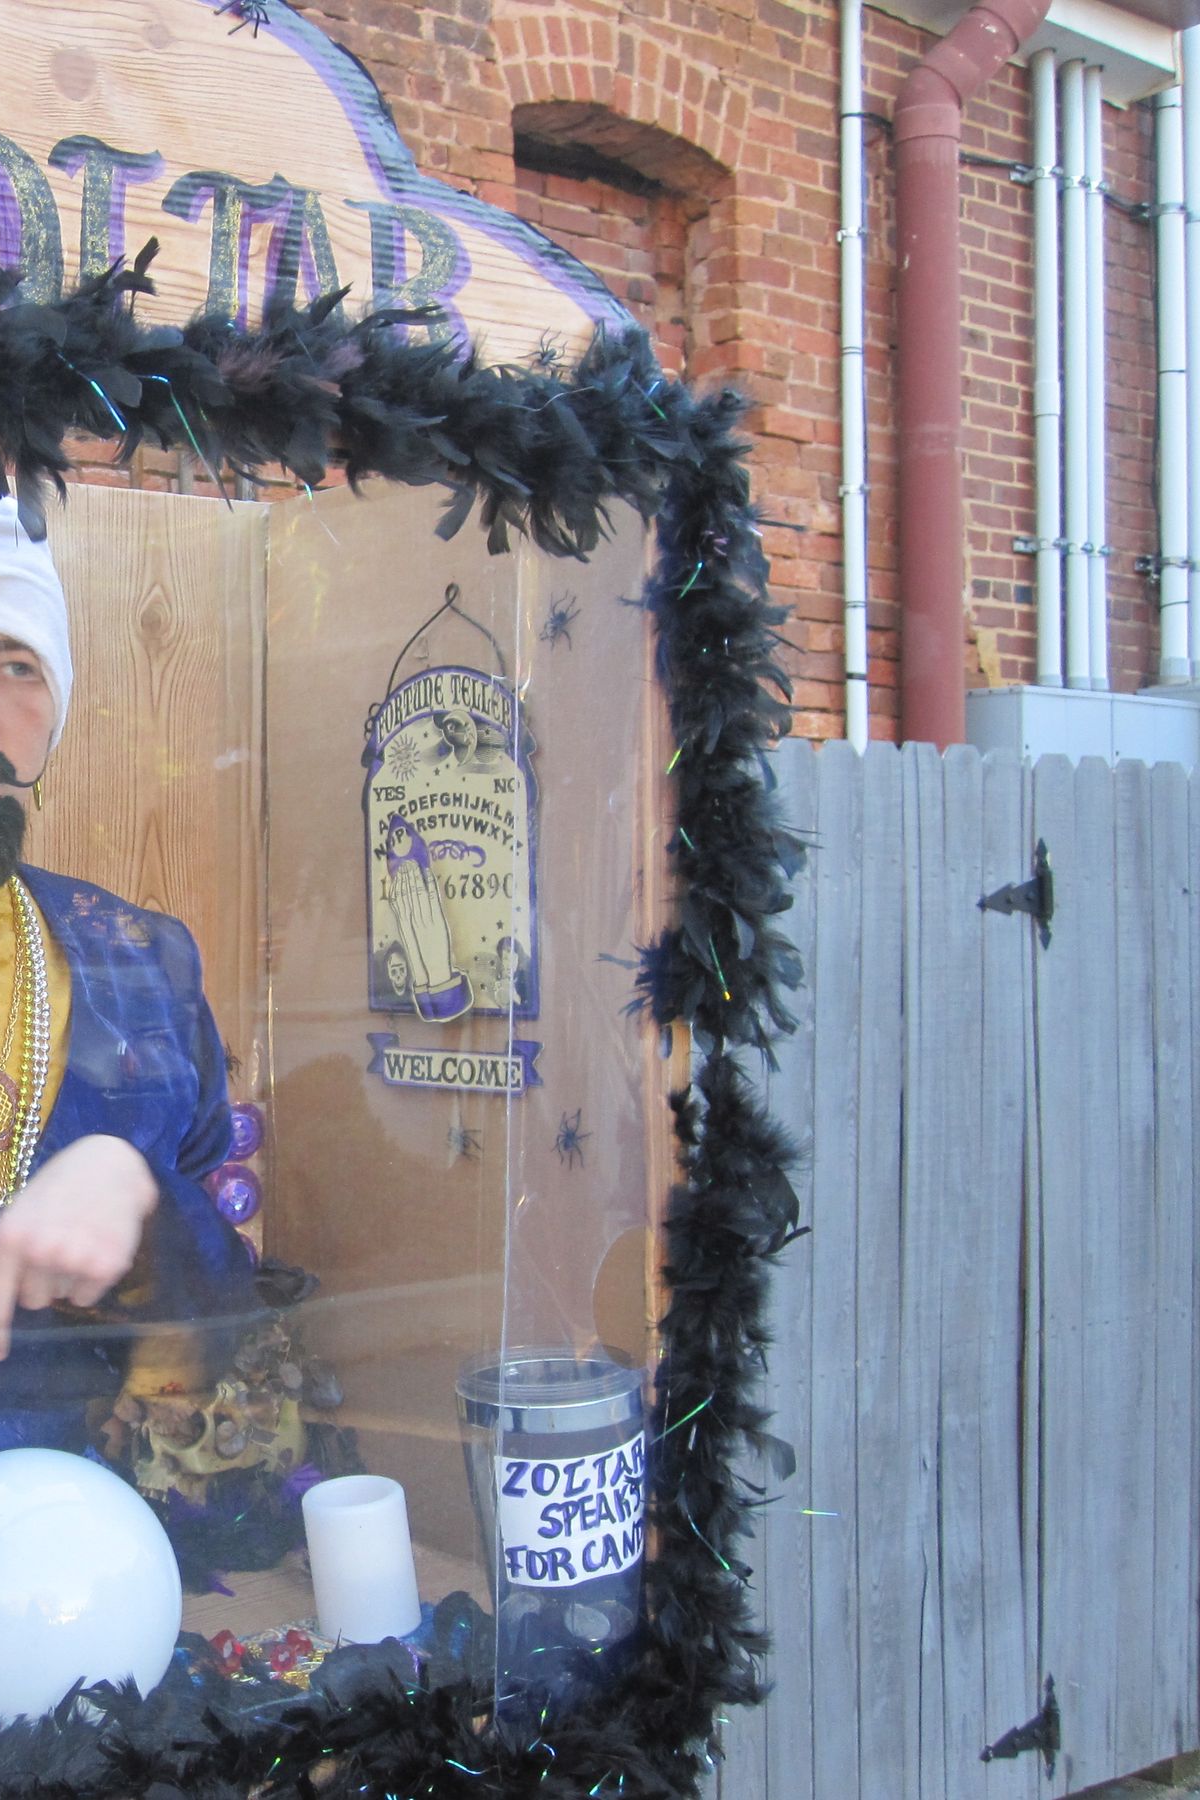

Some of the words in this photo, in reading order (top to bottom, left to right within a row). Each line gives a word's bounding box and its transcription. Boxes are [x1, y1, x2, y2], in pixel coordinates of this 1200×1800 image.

[376, 674, 445, 744] FORTUNE
[451, 674, 512, 729] TELLER
[373, 785, 406, 802] YES
[494, 777, 520, 794] NO
[385, 1052, 522, 1088] WELCOME
[501, 1437, 645, 1498] ZOLTAR
[504, 1544, 577, 1581] FOR
